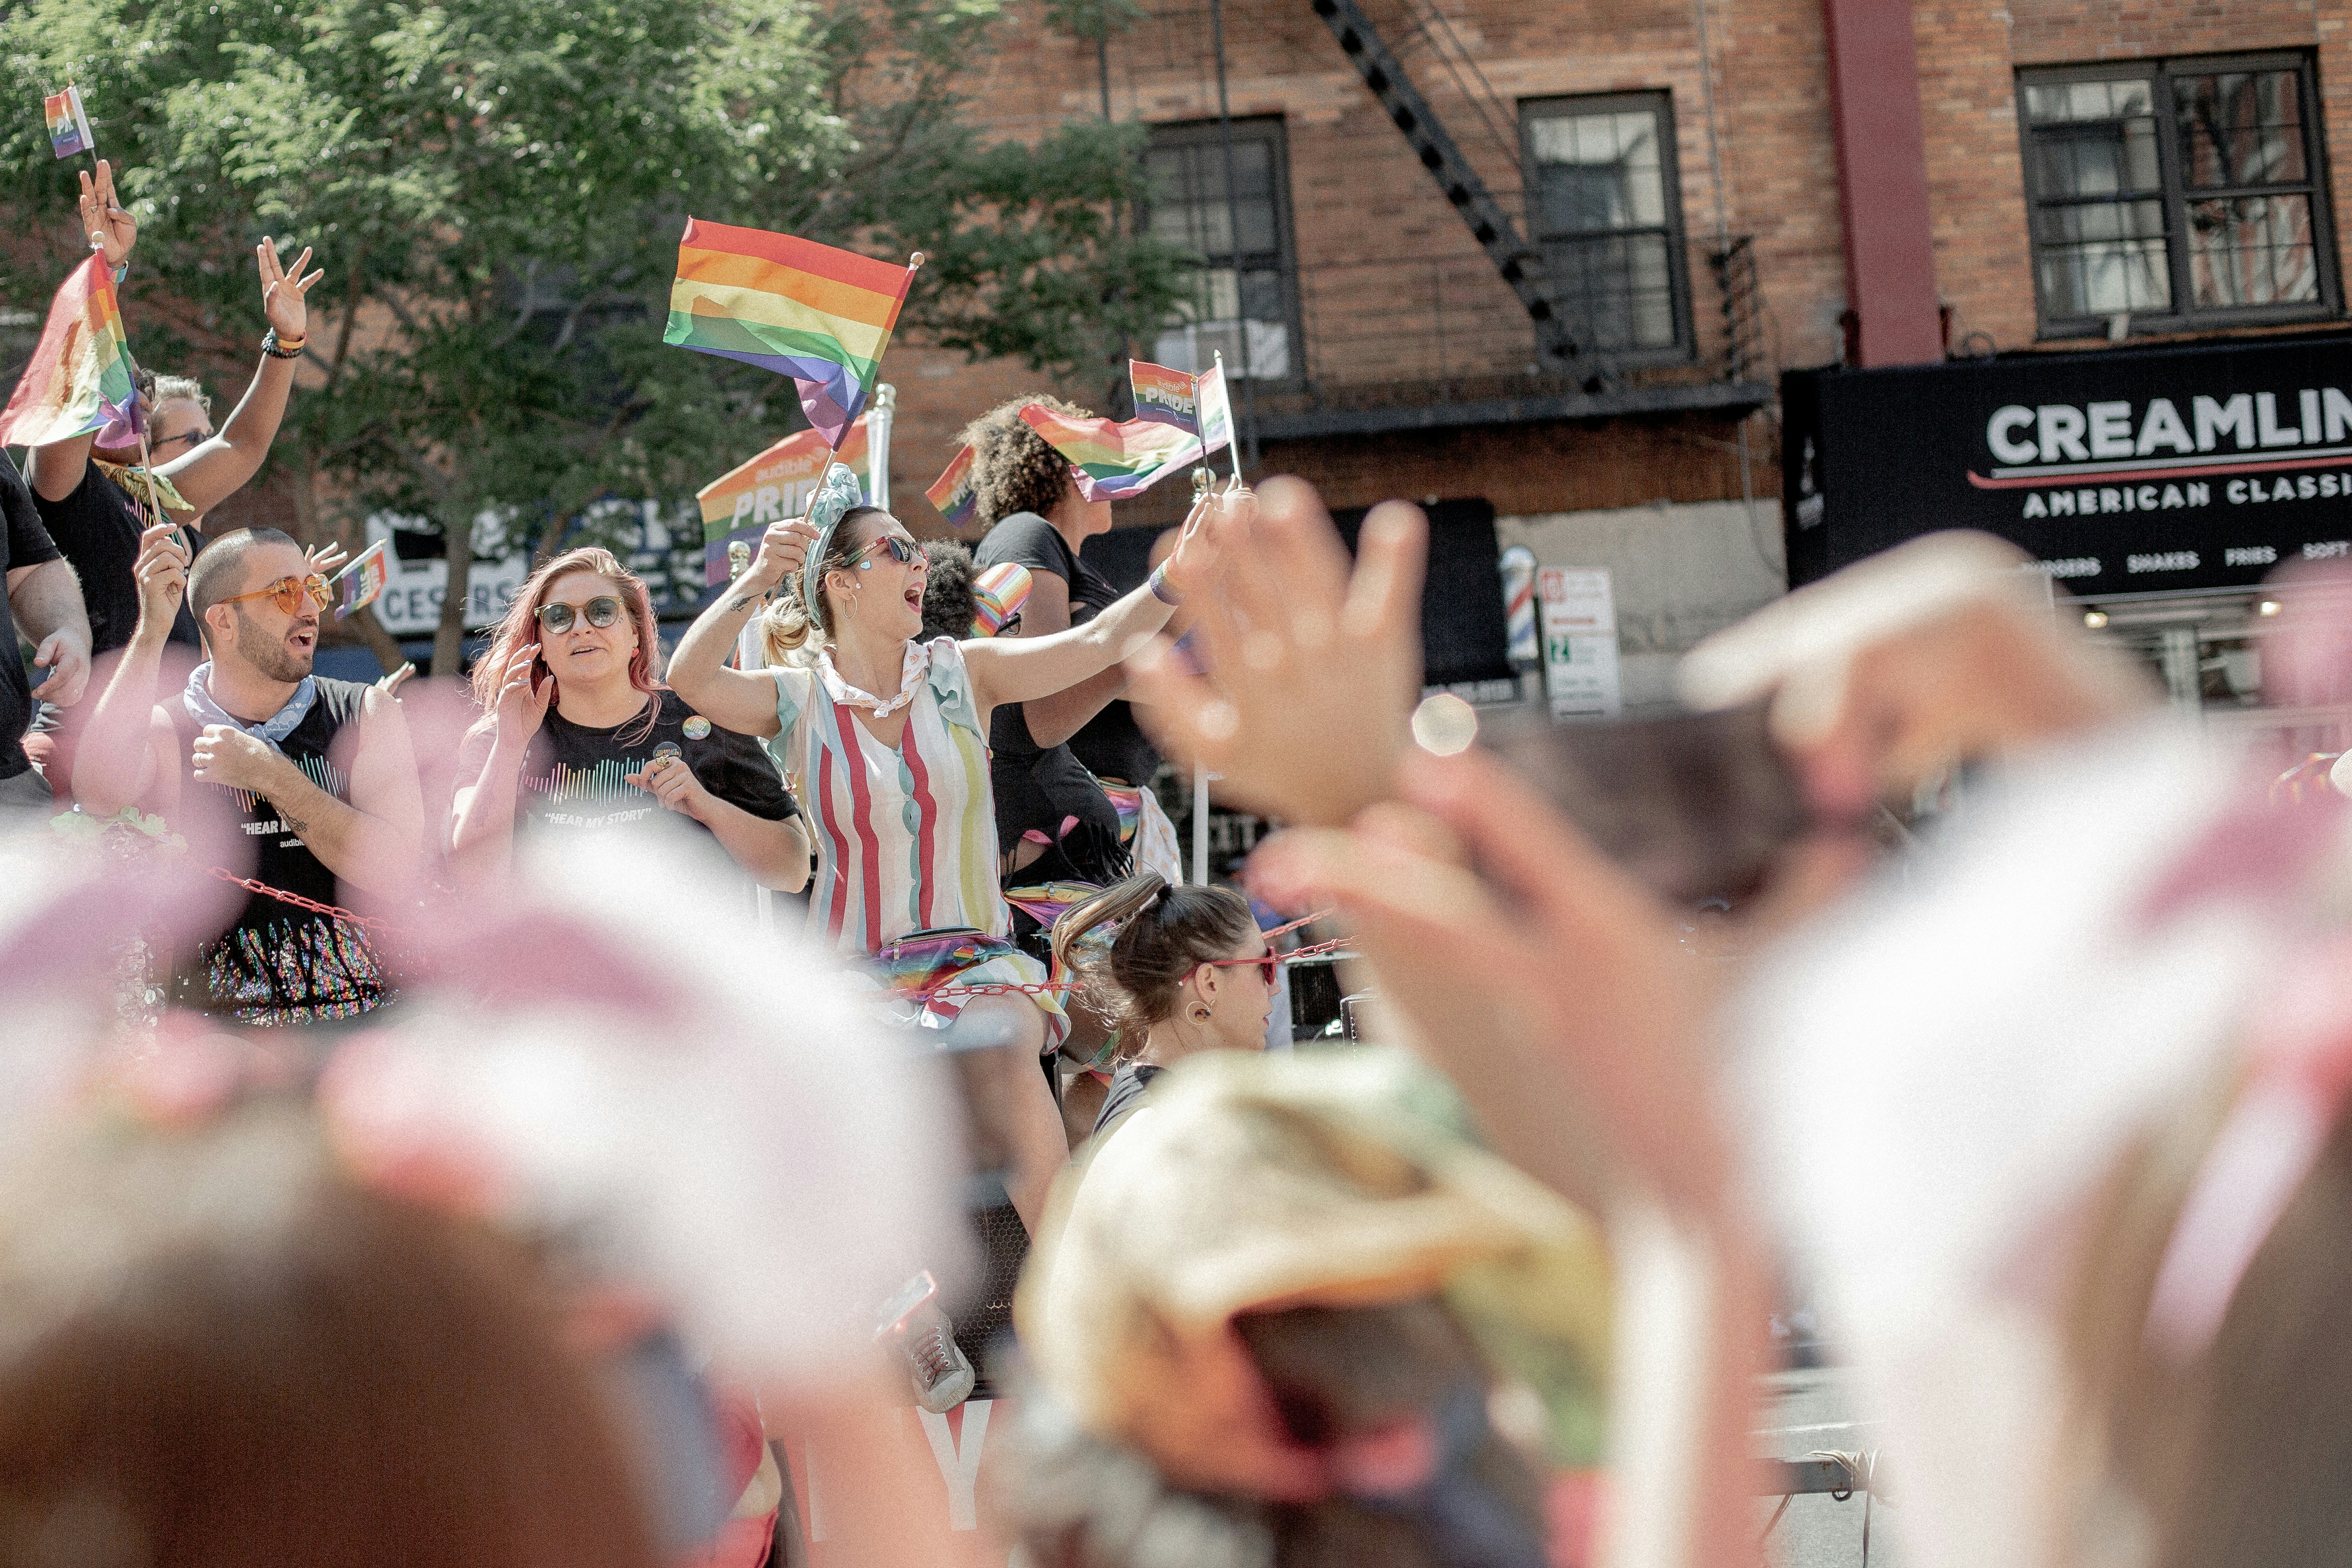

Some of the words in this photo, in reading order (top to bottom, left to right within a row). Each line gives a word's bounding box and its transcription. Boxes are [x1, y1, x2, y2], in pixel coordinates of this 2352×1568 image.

[1157, 379, 1180, 392] audible
[1145, 387, 1194, 414] PRIDE
[2022, 482, 2210, 520] AMERICAN
[2126, 550, 2200, 574] SHAKES
[2224, 545, 2278, 567] FRIES
[2301, 540, 2351, 560] SOFT
[691, 722, 705, 731] STORY
[693, 717, 707, 727] EVERY
[685, 723, 704, 736] MATTERS
[241, 820, 278, 835] “HEAR
[585, 816, 605, 828] MY
